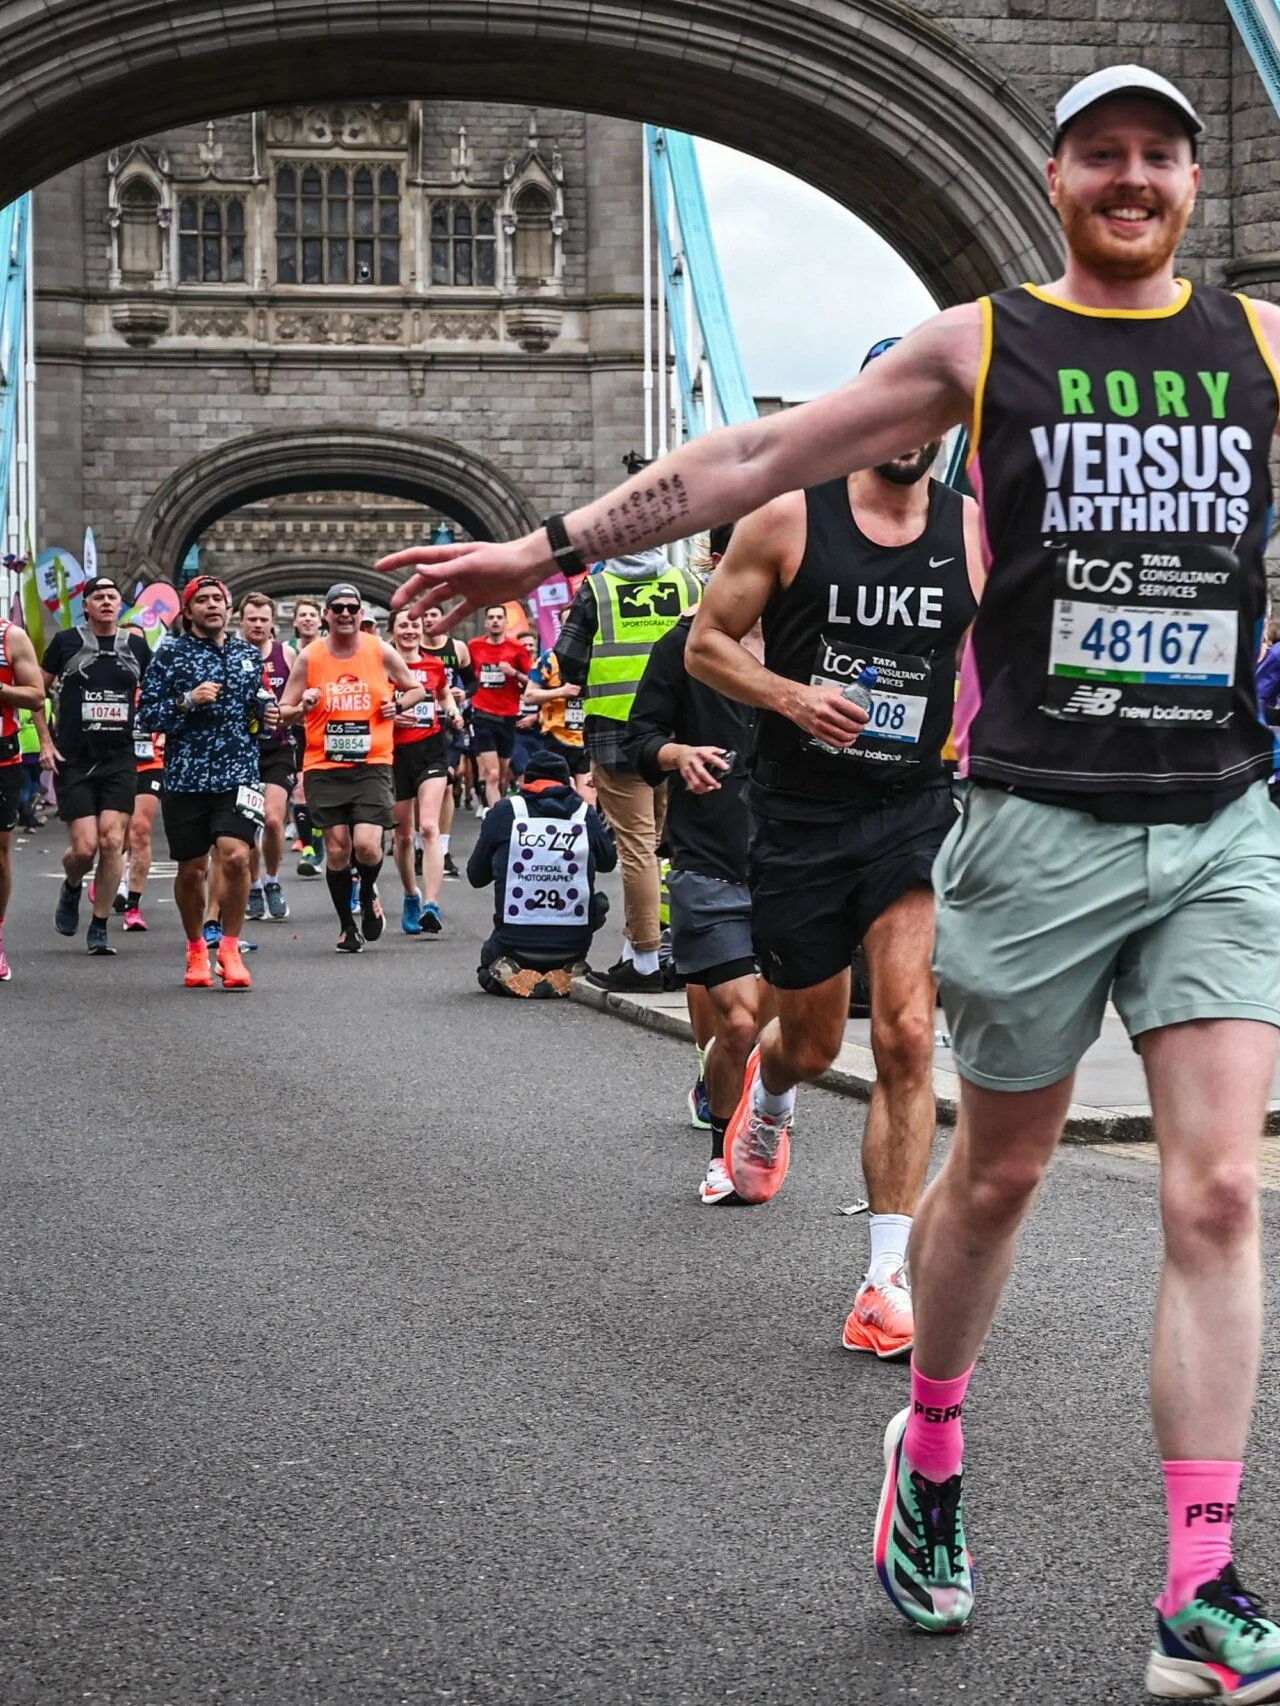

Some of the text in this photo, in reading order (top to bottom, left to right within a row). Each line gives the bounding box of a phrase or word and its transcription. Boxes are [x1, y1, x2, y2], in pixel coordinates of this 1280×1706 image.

[1057, 368, 1230, 419] RORY
[1030, 422, 1253, 496] VERSUS
[1040, 490, 1250, 534] ARTHRITIS
[1140, 554, 1182, 568] TATA
[1066, 549, 1134, 595] tcs
[1138, 569, 1230, 585] CONSULTANCY
[1137, 584, 1198, 599] SERVICES
[828, 584, 944, 629] LUKE
[1080, 617, 1210, 666] 48167
[822, 645, 866, 680] tcs
[872, 656, 897, 668] TATA
[873, 666, 926, 681] ONSULTANCY
[326, 680, 369, 694] Reach
[876, 676, 904, 688] RVICES
[84, 690, 103, 701] tcs
[324, 693, 372, 713] JAMES
[91, 707, 122, 718] 10744
[1119, 705, 1214, 721] new balance
[327, 722, 344, 734] tcs
[331, 738, 365, 750] 39854
[843, 746, 864, 758] new
[517, 829, 547, 848] tcs
[530, 864, 563, 874] OFFICIAL
[517, 873, 575, 883] PHOTOGRAPHER
[534, 889, 561, 909] 29
[914, 1400, 962, 1424] PSR
